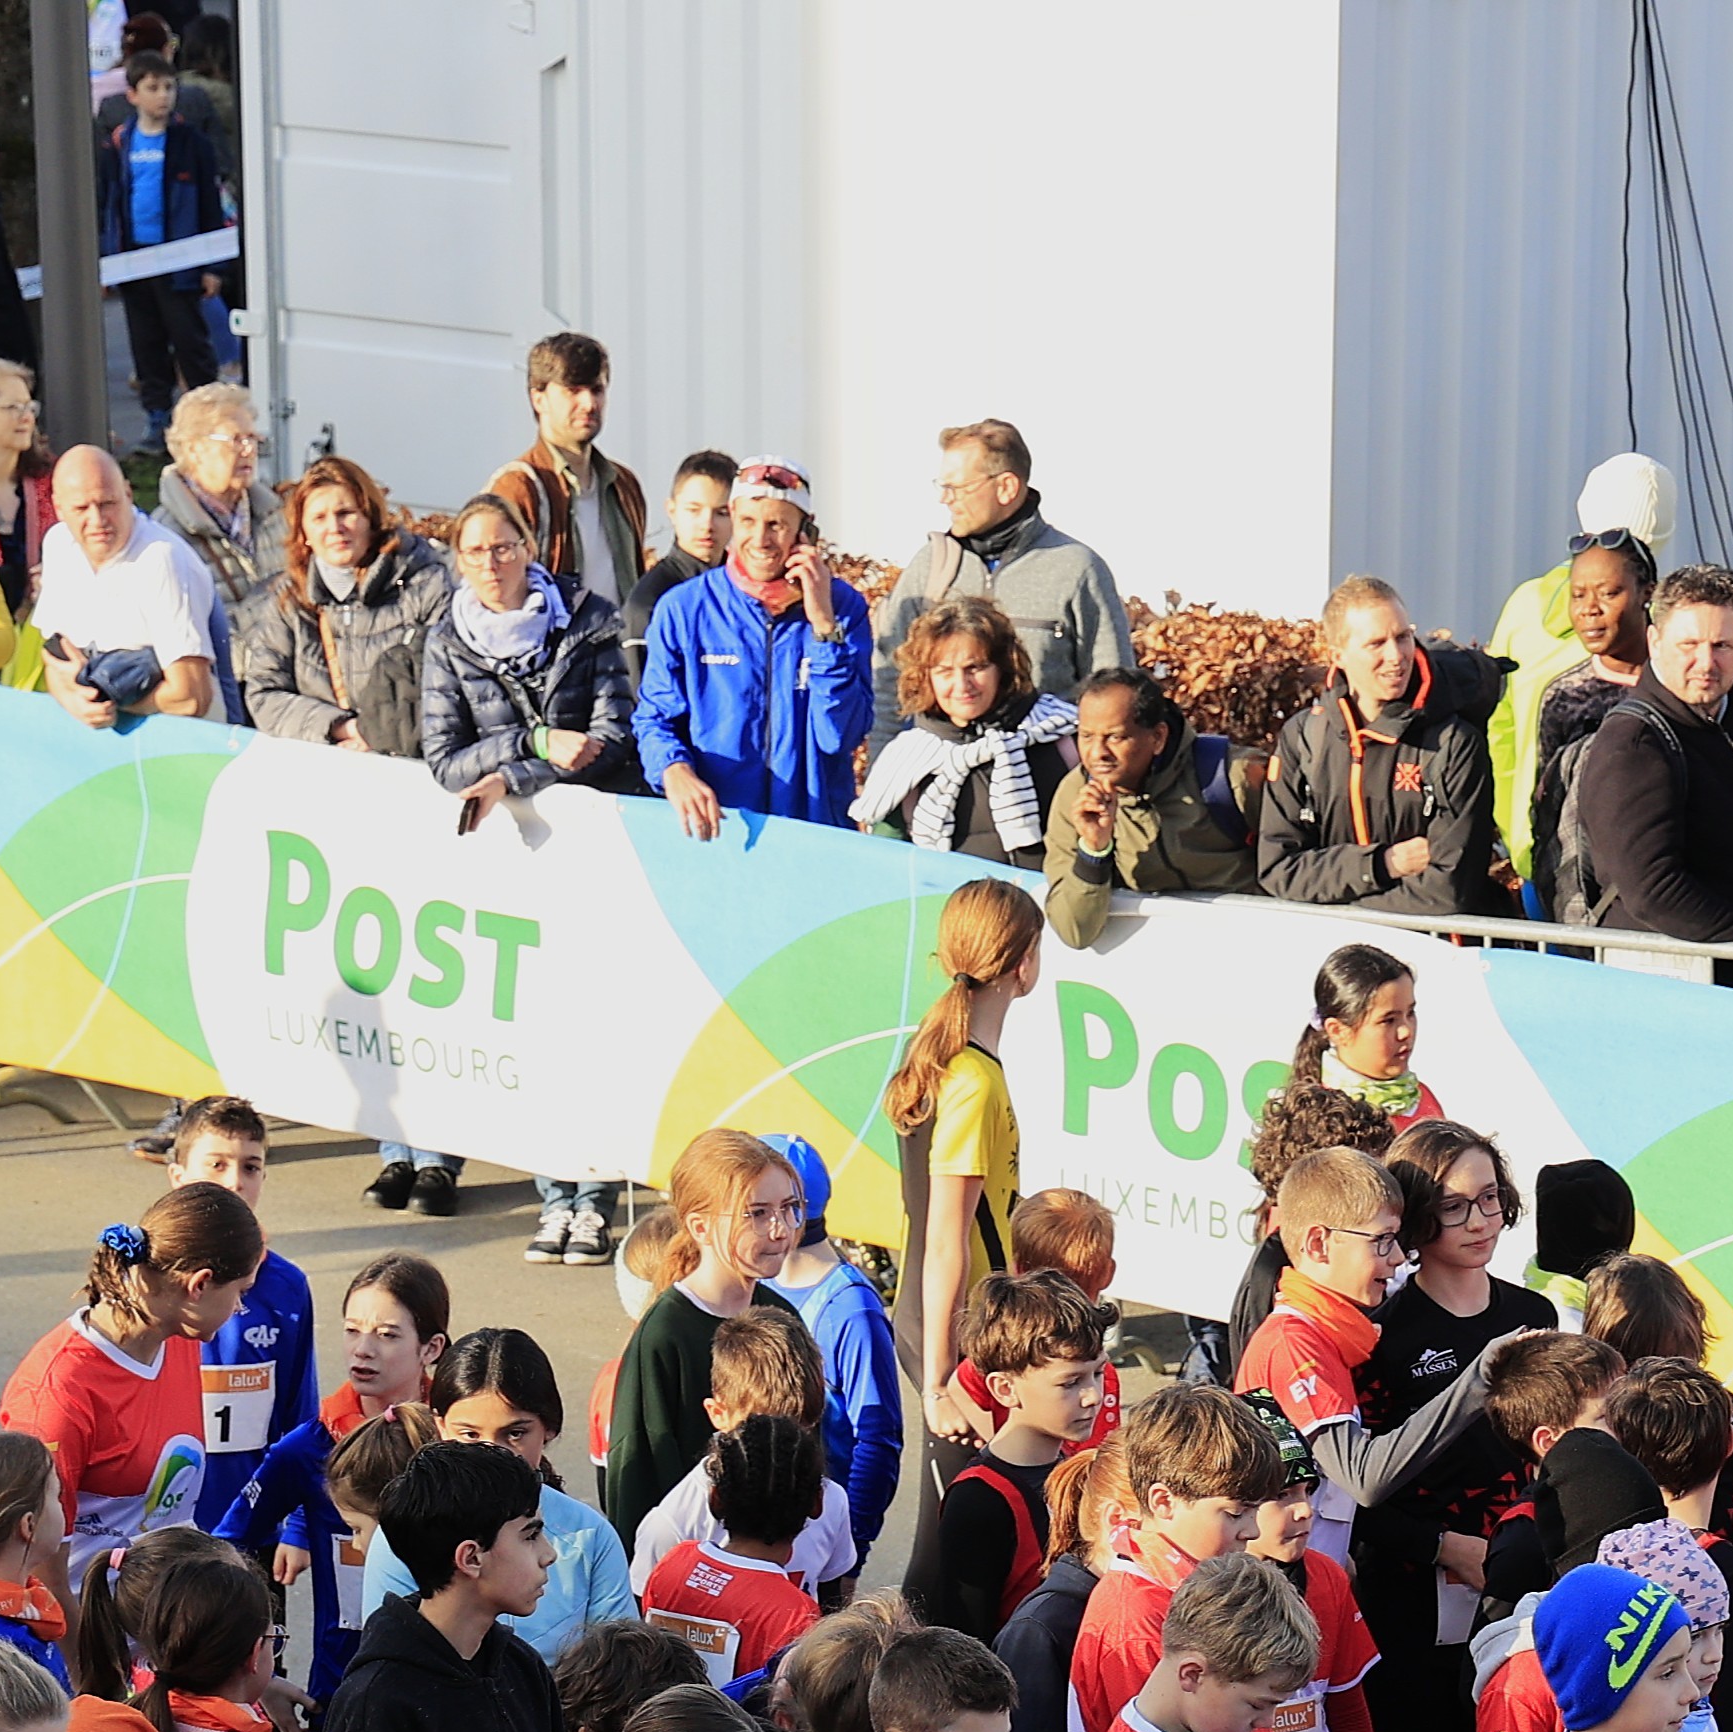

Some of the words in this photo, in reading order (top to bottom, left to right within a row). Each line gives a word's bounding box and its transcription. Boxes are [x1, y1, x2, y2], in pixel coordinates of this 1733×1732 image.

[264, 829, 542, 1023] POST
[267, 1008, 521, 1092] LUXEMBOURG
[1054, 980, 1293, 1170] POS
[228, 1371, 262, 1387] lalux
[1411, 1359, 1459, 1379] MASSEN
[1289, 1373, 1319, 1404] EY
[213, 1404, 232, 1443] 1
[689, 1574, 724, 1592] SPORTS
[692, 1567, 729, 1587] PETERS
[1604, 1579, 1671, 1652] NIK
[686, 1625, 714, 1646] lalux
[1271, 1710, 1308, 1731] alux
